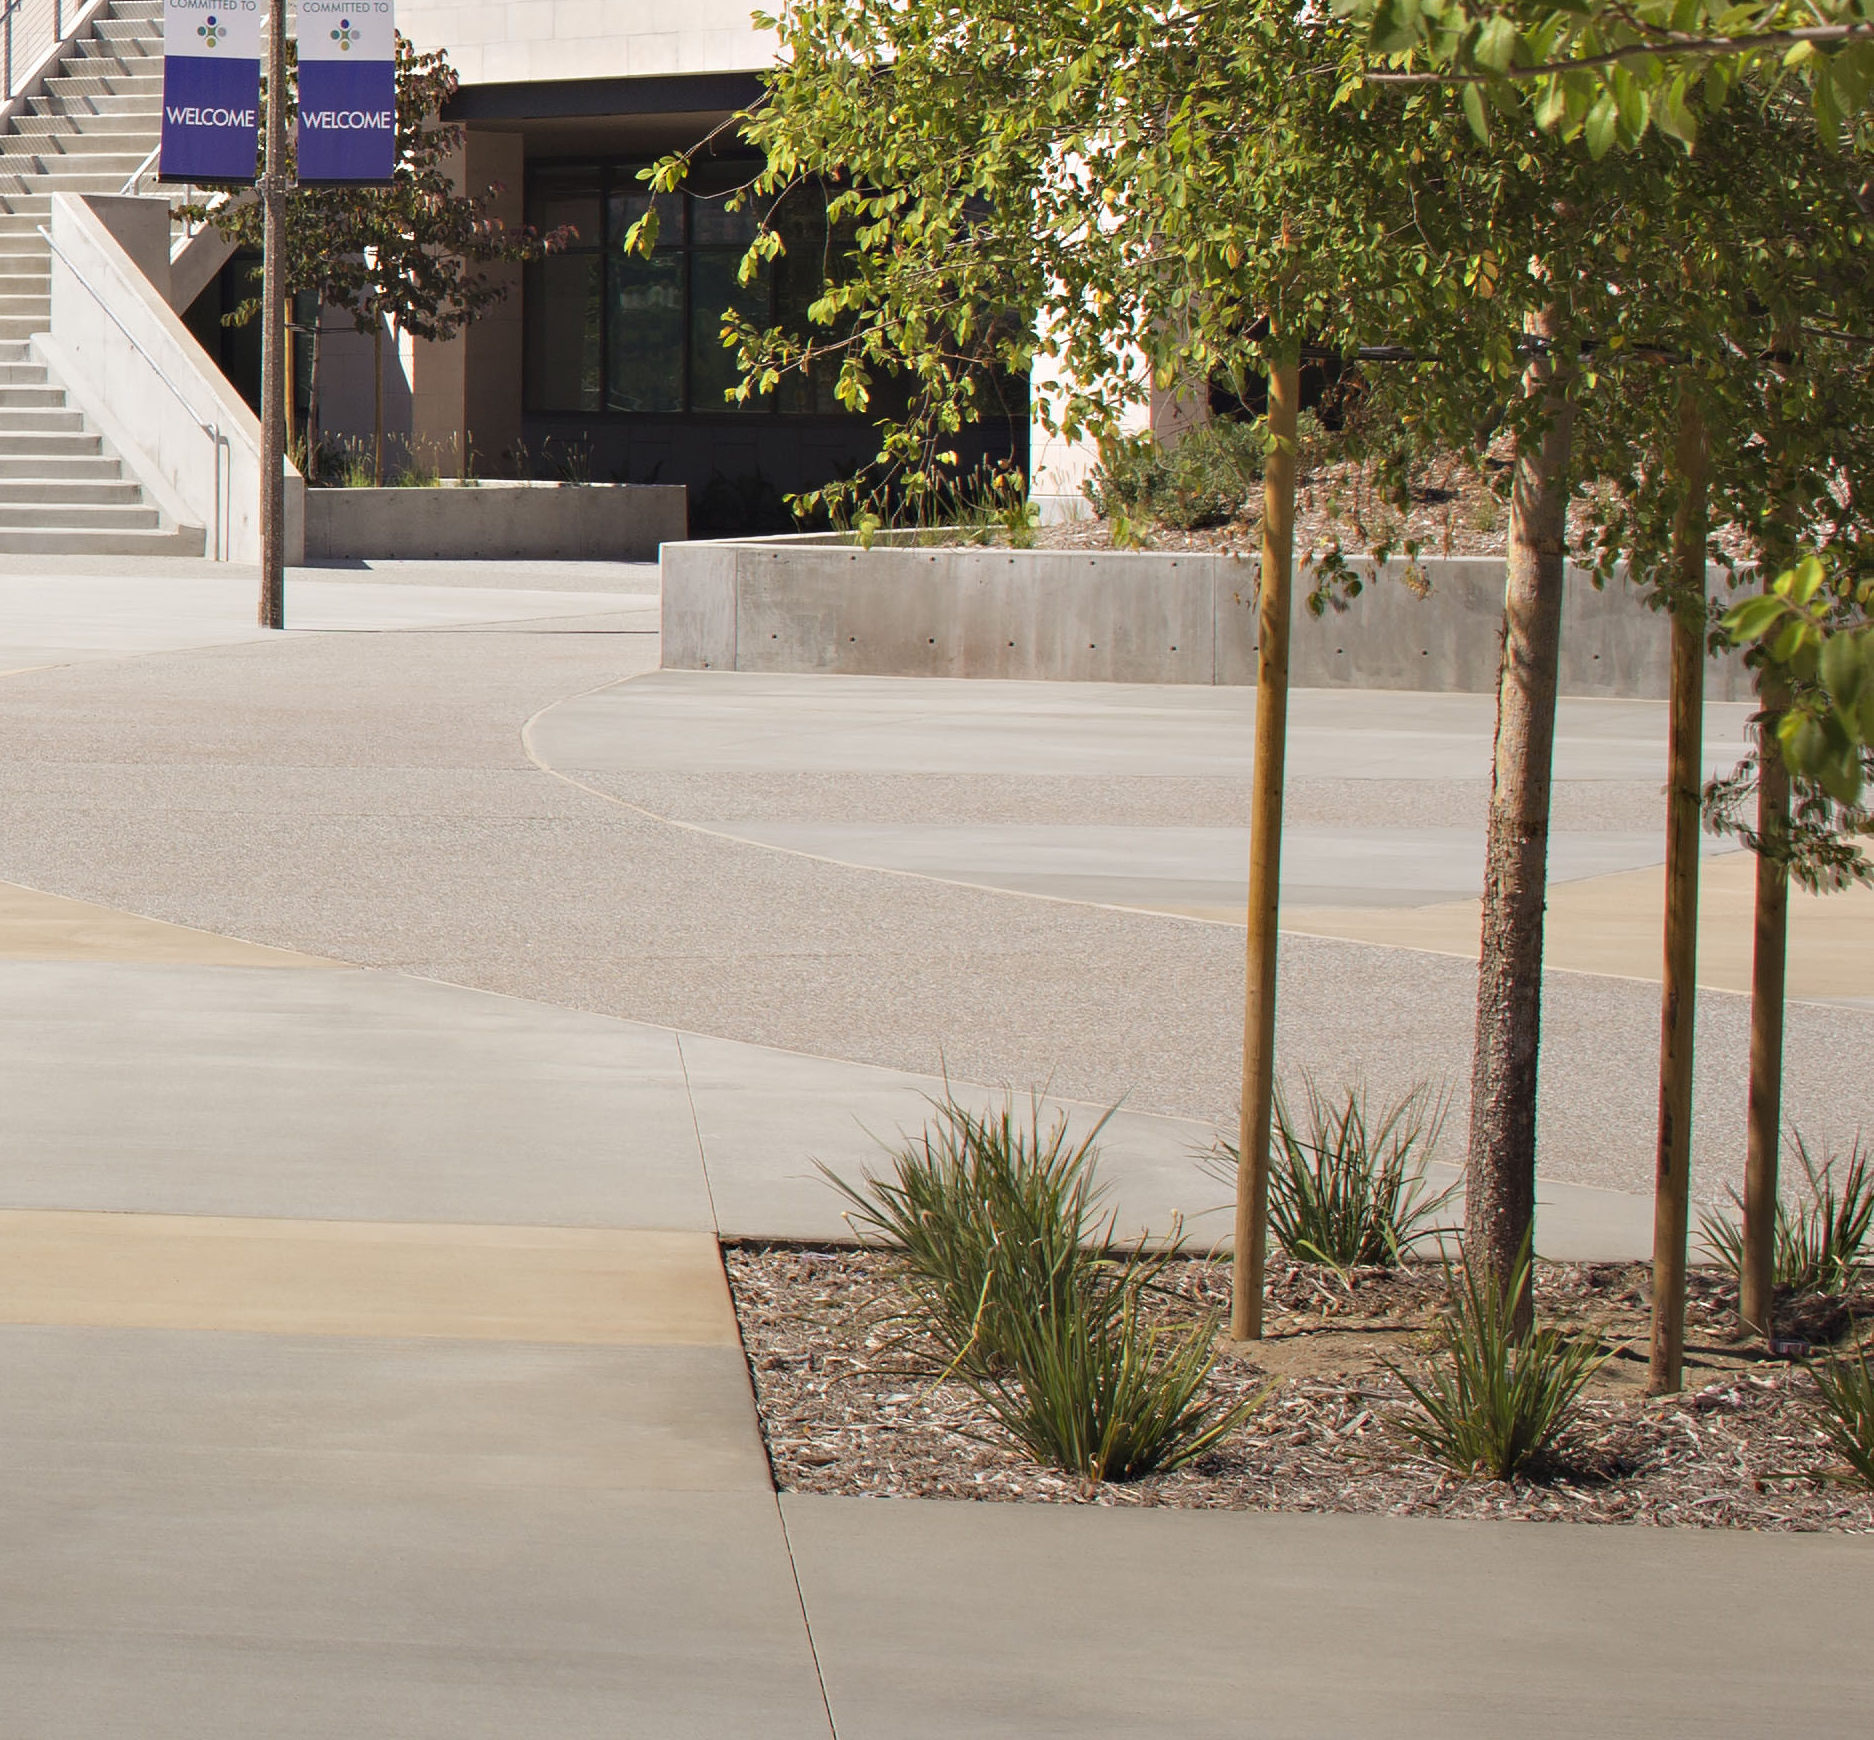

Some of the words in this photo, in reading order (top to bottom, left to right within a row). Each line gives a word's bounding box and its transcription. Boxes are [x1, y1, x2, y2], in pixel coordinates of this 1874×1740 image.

[241, 0, 256, 11] TO
[303, 2, 370, 13] COMMITTED
[373, 2, 389, 13] TO
[167, 107, 255, 127] WELCOME
[302, 111, 391, 129] WELCOME
